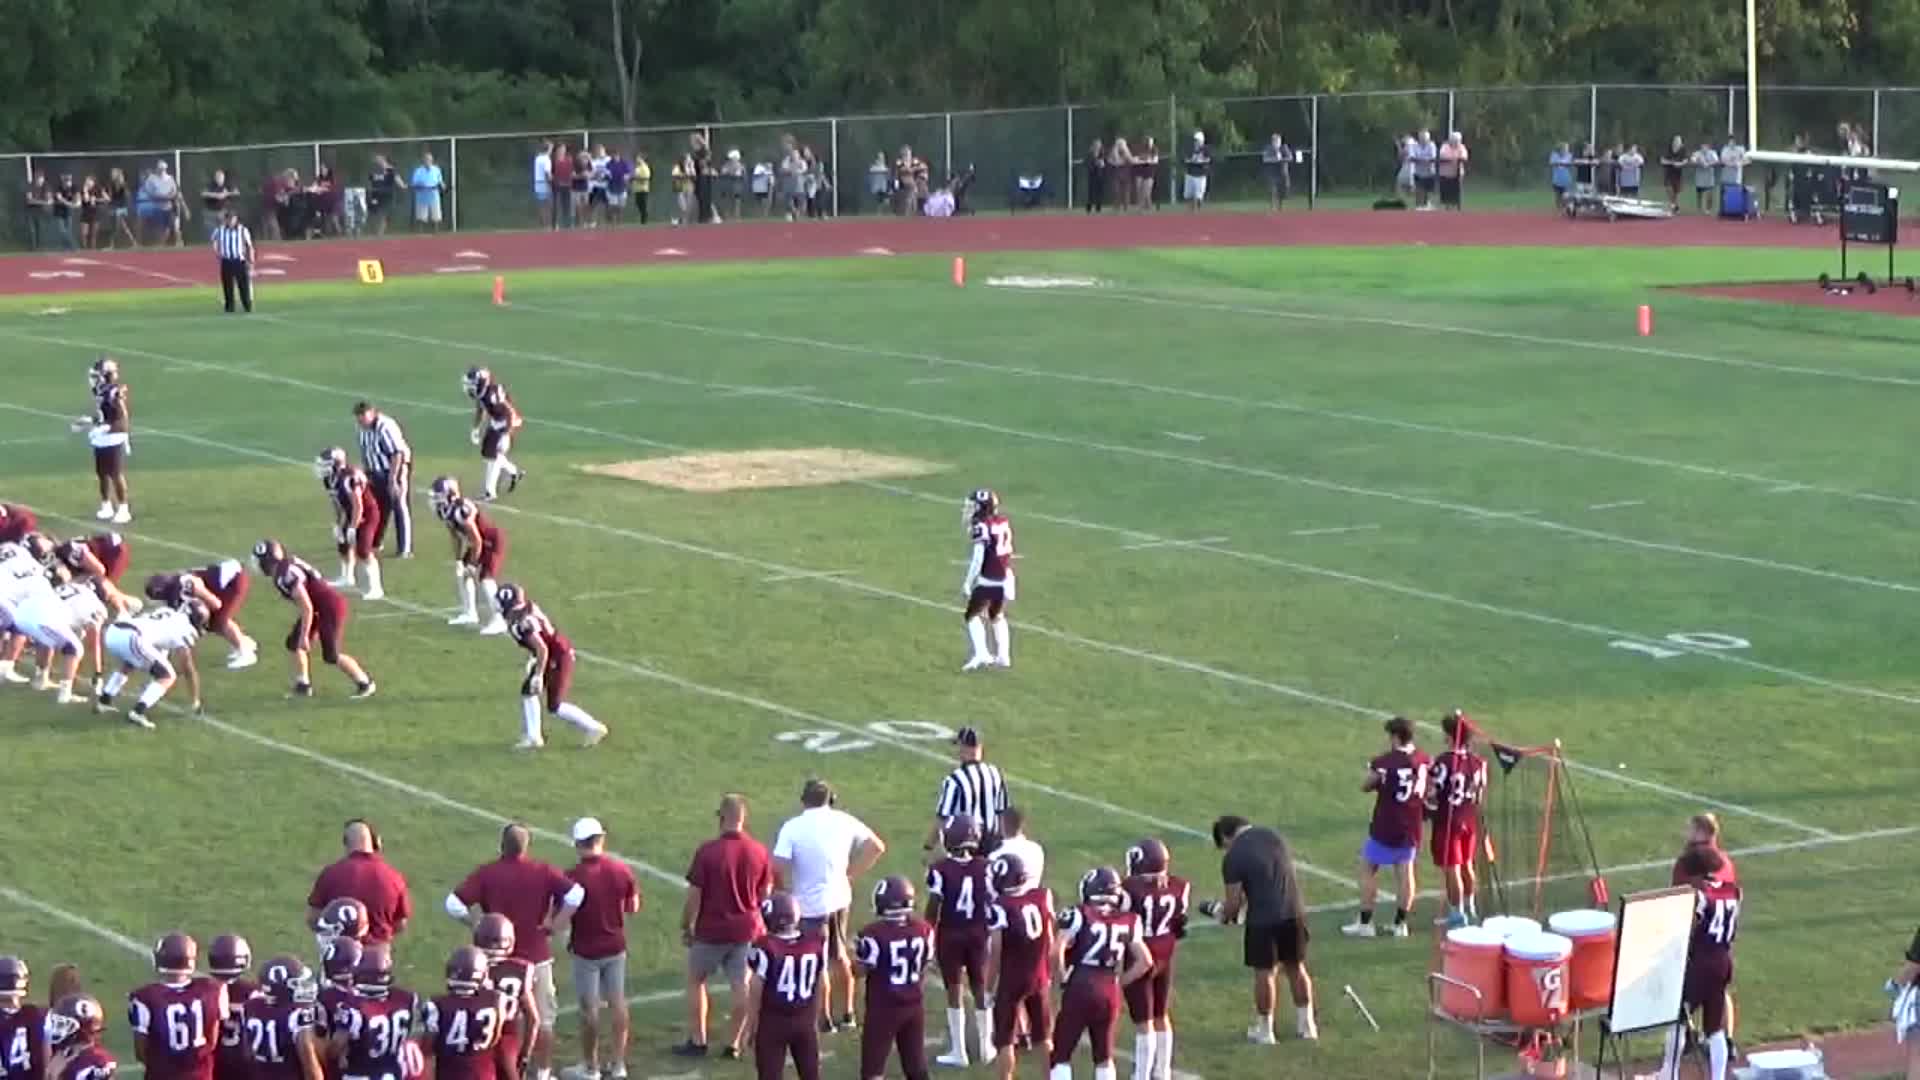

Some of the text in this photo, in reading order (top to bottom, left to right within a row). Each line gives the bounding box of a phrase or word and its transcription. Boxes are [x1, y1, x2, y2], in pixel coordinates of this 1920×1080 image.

[956, 875, 974, 920] 4
[1143, 894, 1177, 938] 12
[1022, 903, 1043, 941] 0
[1082, 921, 1130, 967] 25
[1709, 898, 1740, 944] 47
[776, 953, 818, 1002] 40
[166, 998, 207, 1051] 61
[247, 1017, 284, 1063] 21
[445, 1007, 498, 1052] 43
